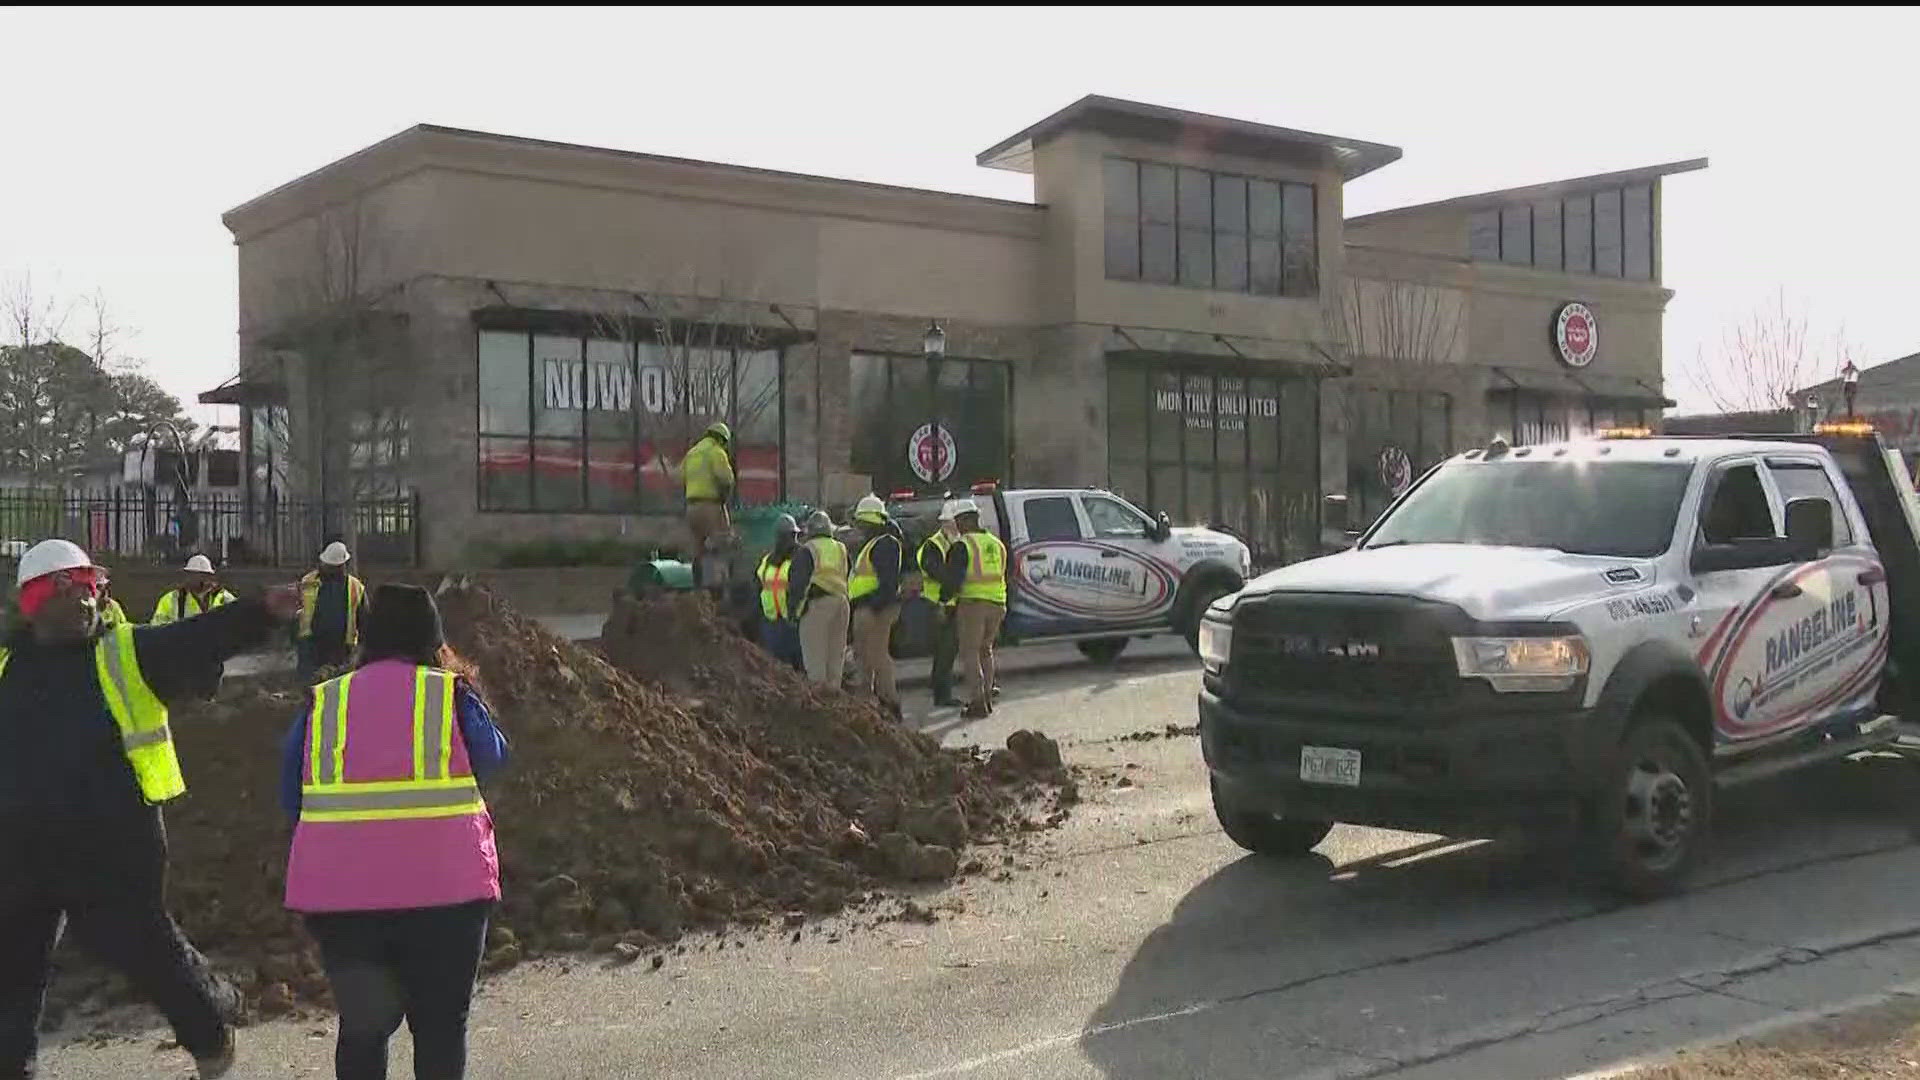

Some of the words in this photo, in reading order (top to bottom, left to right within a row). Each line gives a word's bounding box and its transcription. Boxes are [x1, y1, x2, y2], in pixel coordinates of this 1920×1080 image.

[544, 359, 632, 411] NOW
[1156, 390, 1211, 413] MONTHLY
[1217, 394, 1277, 416] UNLIMITED
[1185, 418, 1213, 429] WASH
[1053, 557, 1131, 587] RANGELINE
[1766, 590, 1856, 674] RANGELINE
